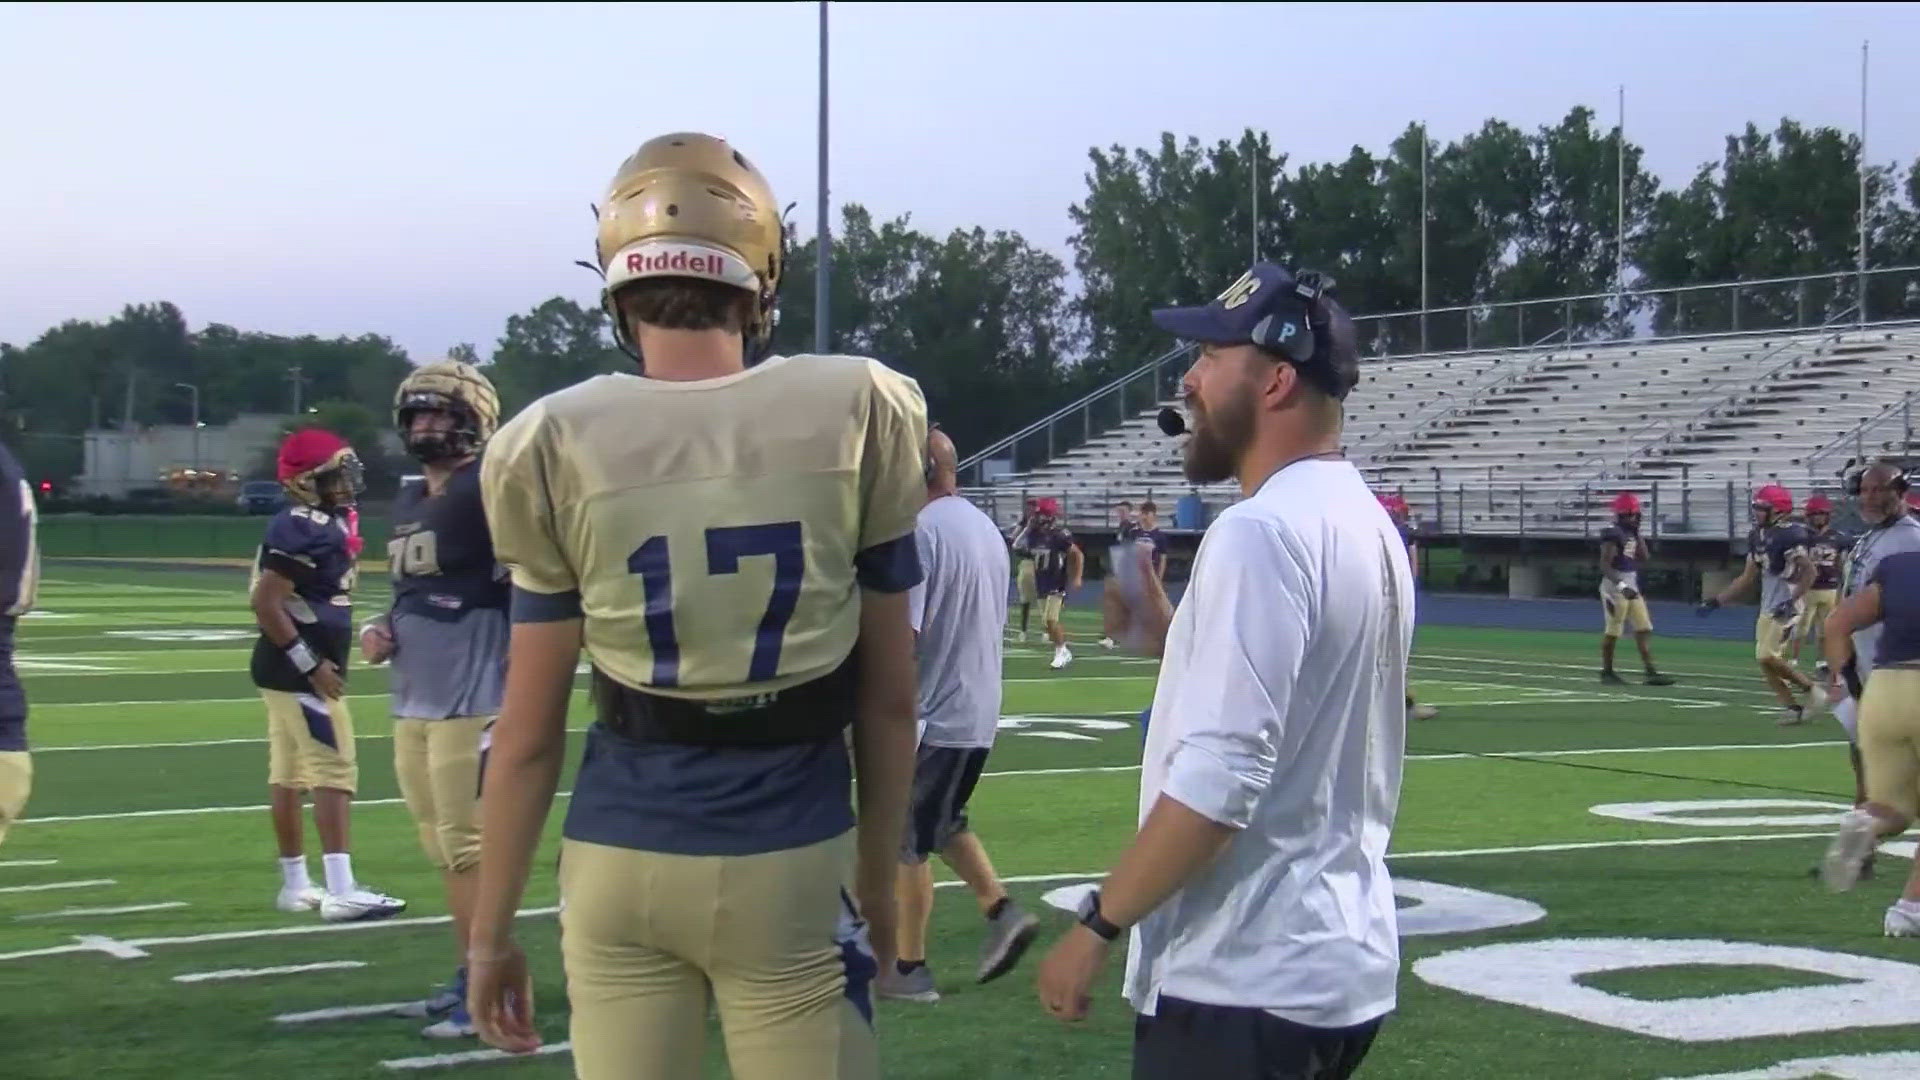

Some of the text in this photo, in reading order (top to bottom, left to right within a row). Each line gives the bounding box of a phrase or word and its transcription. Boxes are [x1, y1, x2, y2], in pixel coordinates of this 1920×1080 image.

[627, 251, 724, 275] Riddell
[1277, 322, 1297, 343] P
[627, 521, 805, 687] 17
